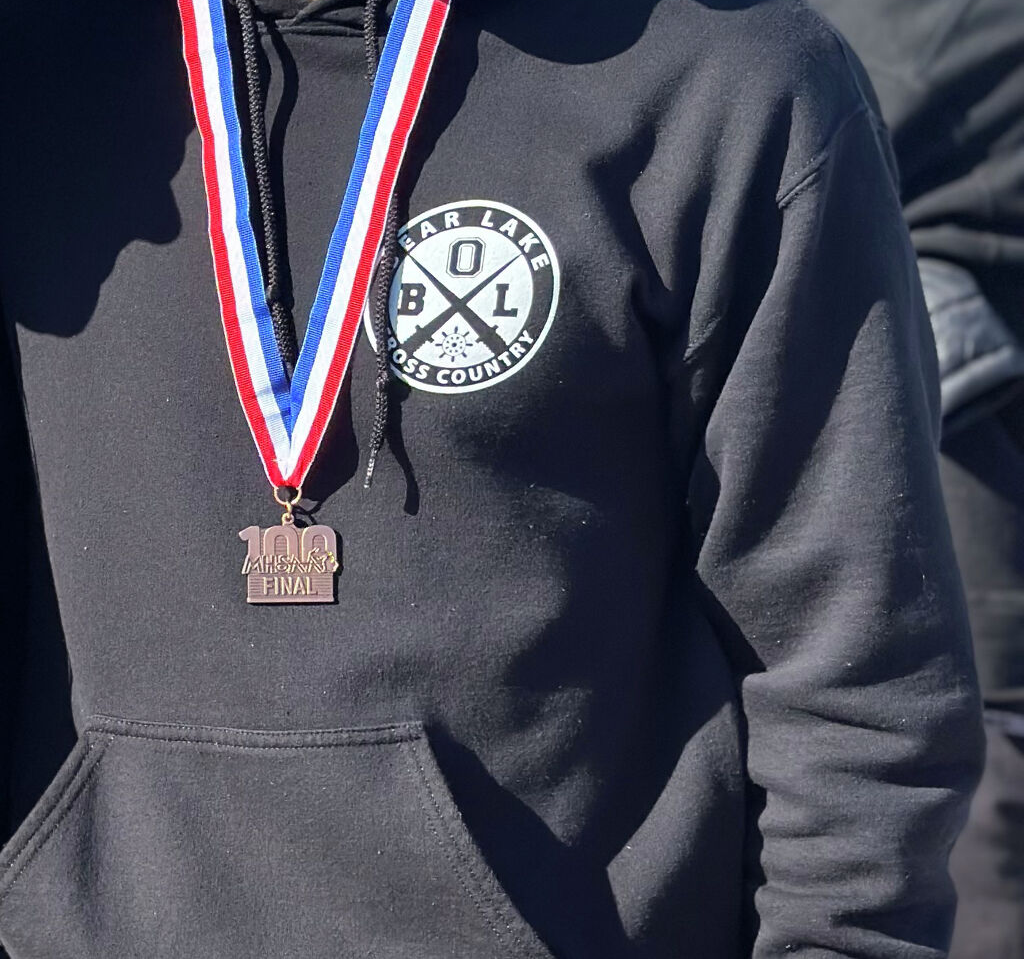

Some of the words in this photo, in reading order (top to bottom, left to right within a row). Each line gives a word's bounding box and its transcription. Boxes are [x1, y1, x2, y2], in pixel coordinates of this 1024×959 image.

[395, 211, 460, 267] EAR
[481, 210, 551, 271] LAKE
[446, 237, 486, 278] O
[397, 283, 426, 316] B
[492, 283, 518, 317] L
[387, 327, 430, 380] ROSS
[436, 330, 534, 385] COUNTRY
[239, 525, 337, 562] 100
[263, 576, 318, 596] FINAL
